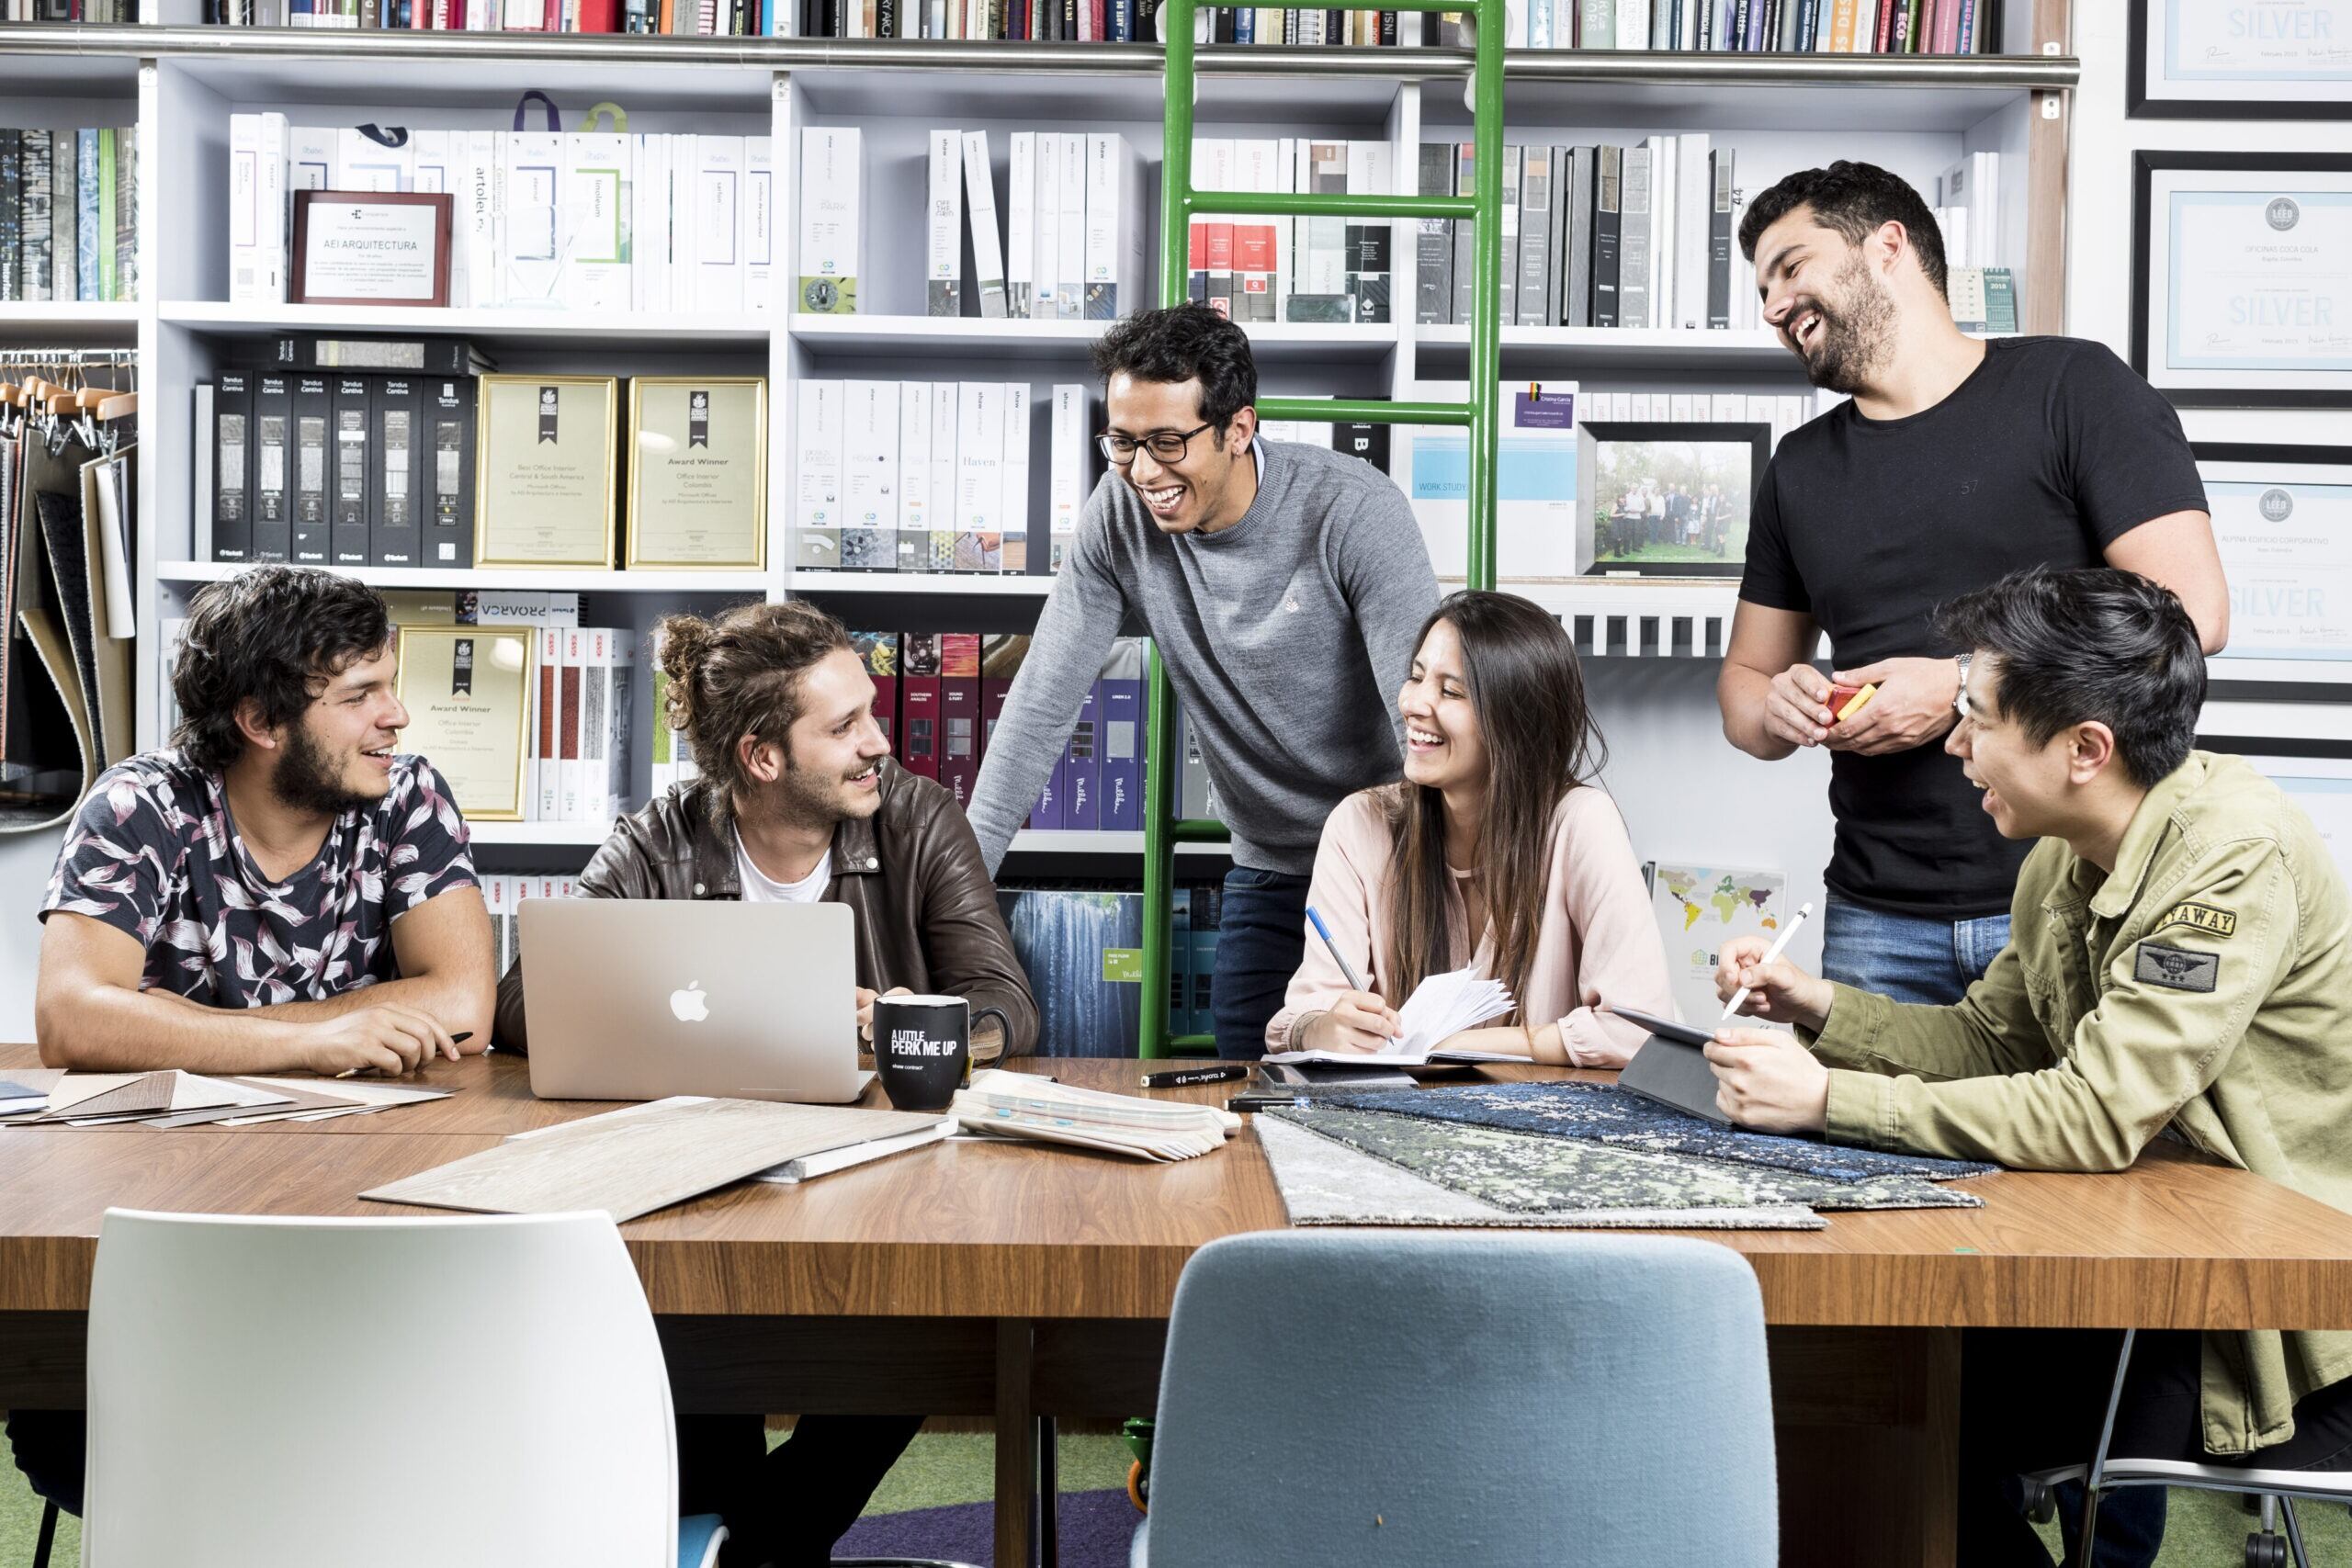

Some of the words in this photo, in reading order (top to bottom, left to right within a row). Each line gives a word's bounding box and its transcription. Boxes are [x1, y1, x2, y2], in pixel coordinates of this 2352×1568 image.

[1116, 10, 1125, 27] ARTE
[2227, 7, 2334, 39] SILVER
[1896, 12, 1908, 40] ECO
[1962, 28, 1970, 51] NEW
[820, 201, 847, 212] PARK
[342, 240, 418, 251] ARQUITECTURA
[2245, 245, 2278, 254] OFICINAS
[2278, 245, 2299, 254] COCA
[2300, 245, 2319, 254] COLA
[2, 263, 13, 301] Interface
[1990, 282, 2007, 290] 2018
[2229, 295, 2333, 326] SILVER
[341, 387, 364, 395] Centiva
[963, 456, 996, 468] Haven
[2222, 535, 2246, 543] ALPINA
[2248, 536, 2278, 544] EDIFICIO
[2280, 536, 2329, 545] CORPORATIVO
[481, 604, 547, 617] PROARCA
[459, 705, 492, 714] Winner
[1075, 777, 1087, 815] Milliken
[1114, 777, 1125, 815] Milliken
[891, 1029, 898, 1041] A
[898, 1030, 926, 1042] LITTLE
[891, 1039, 922, 1056] PERK
[922, 1041, 941, 1056] ME
[942, 1040, 957, 1056] UP
